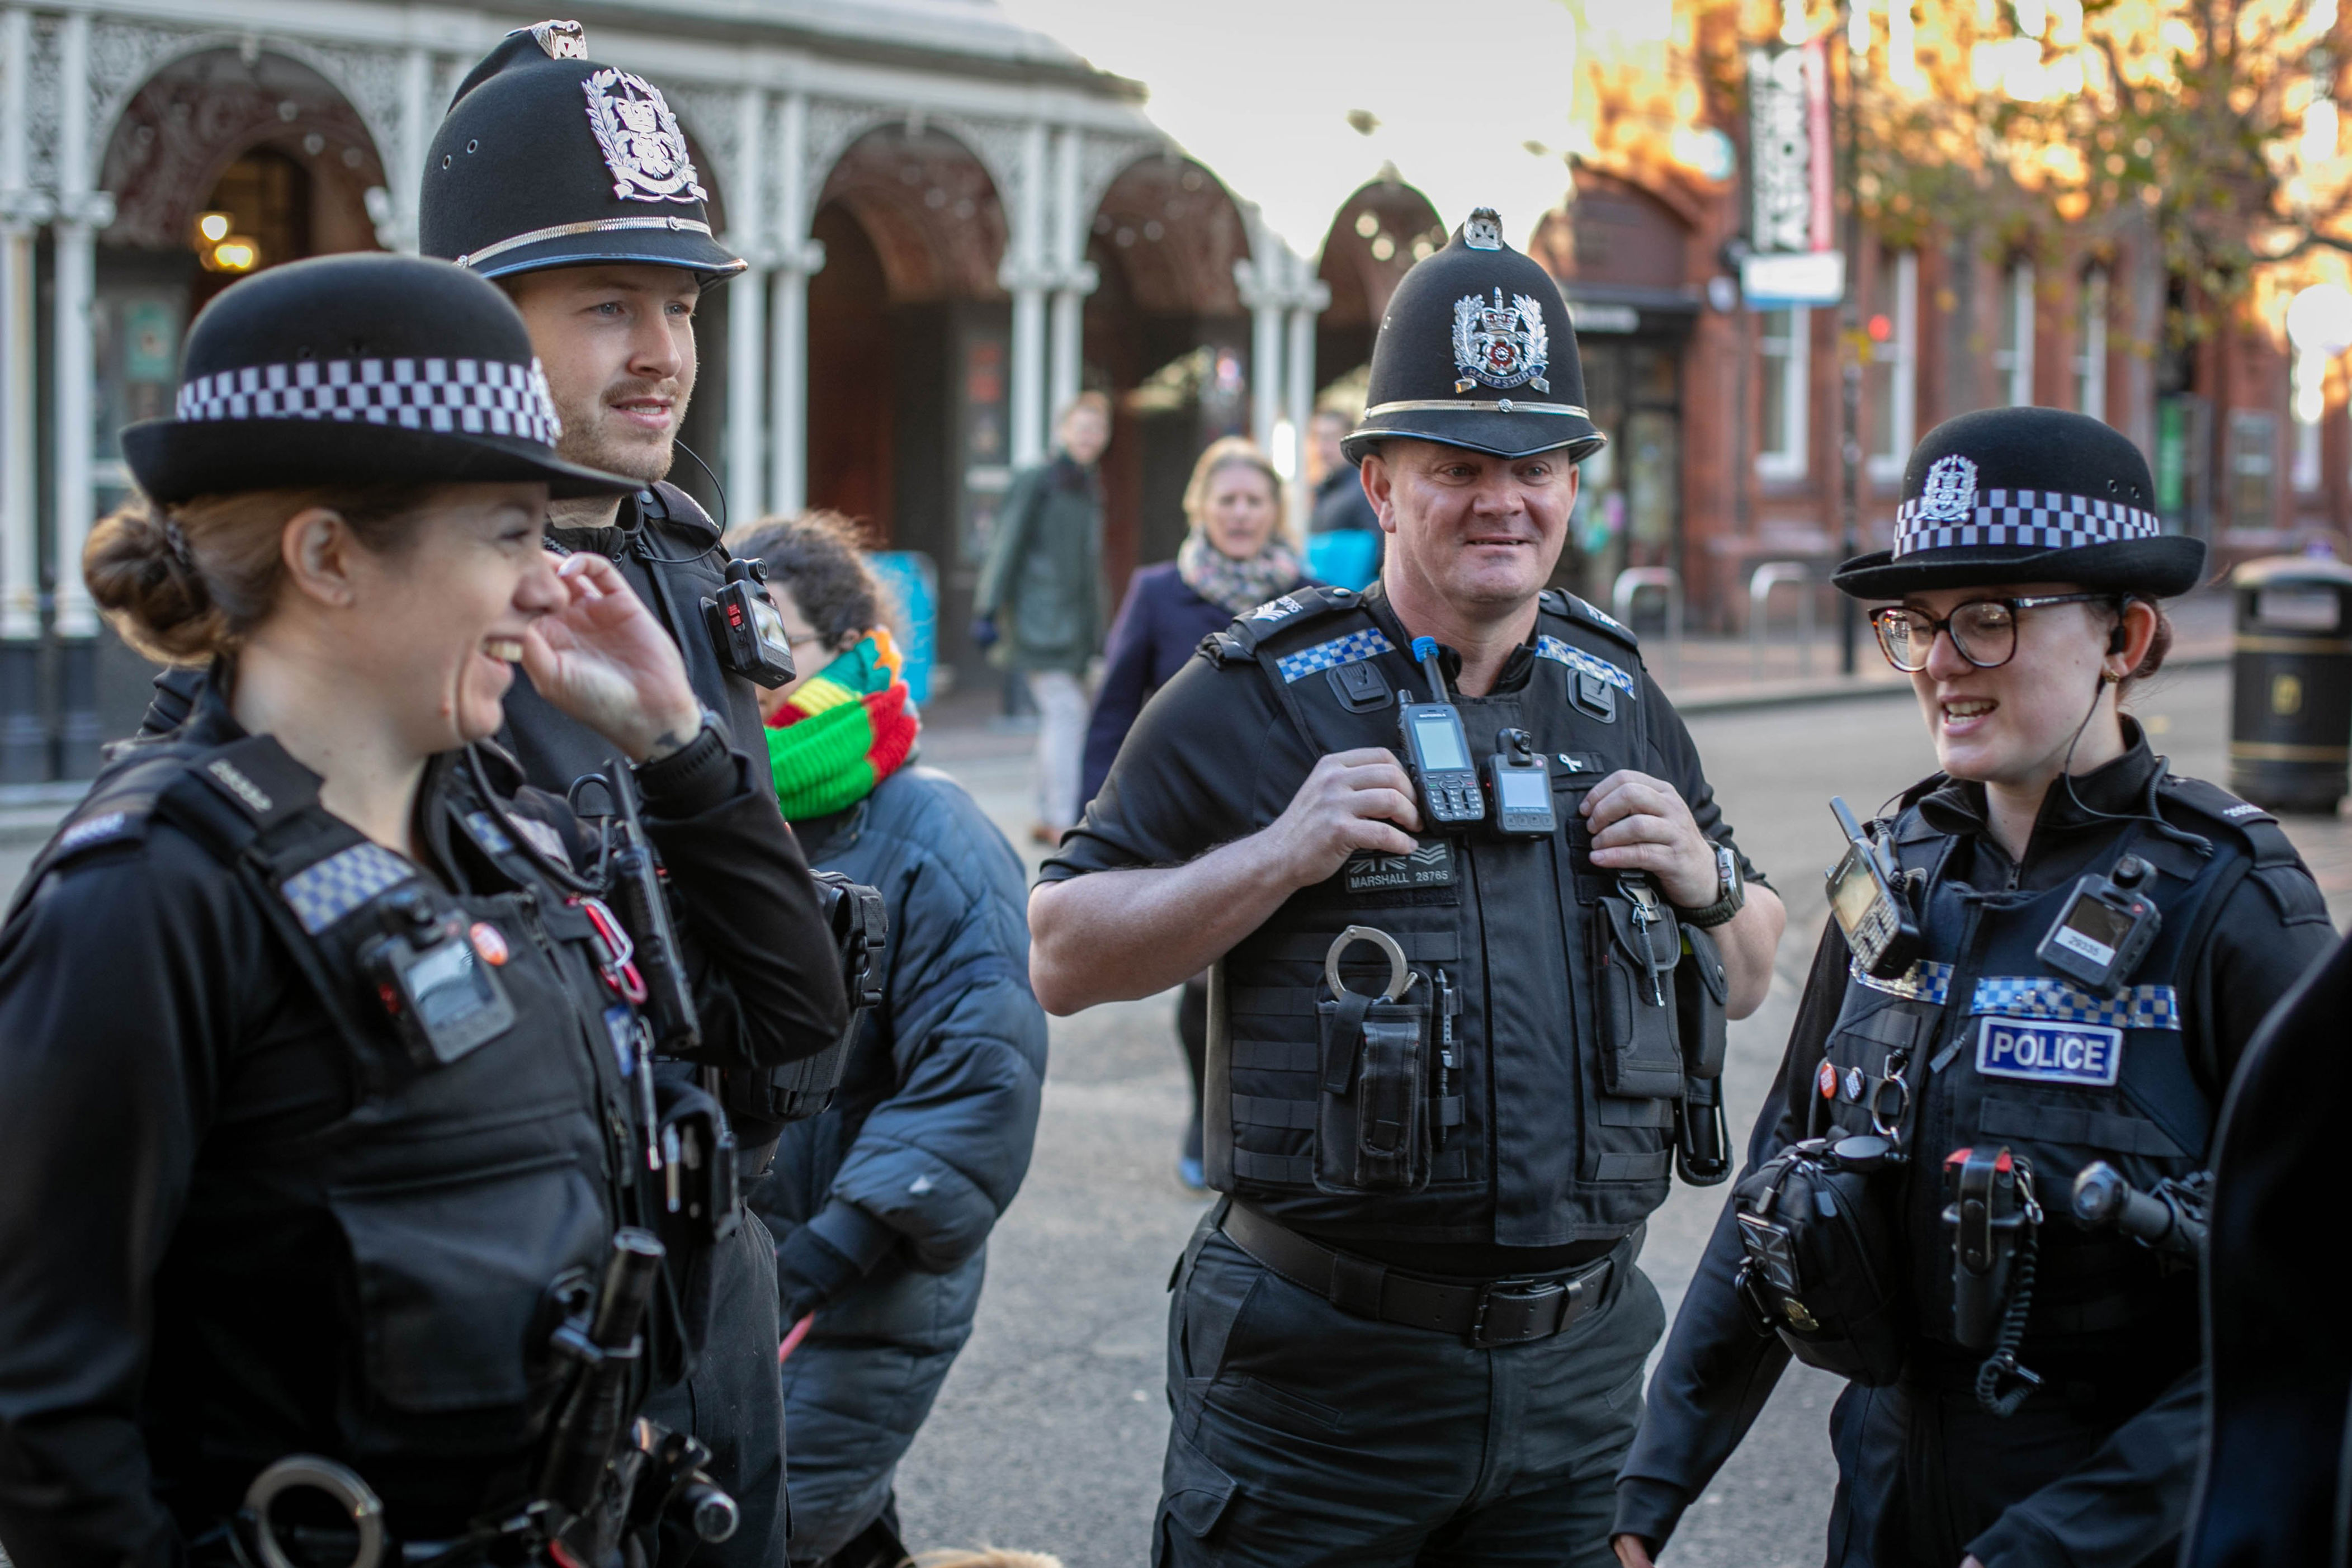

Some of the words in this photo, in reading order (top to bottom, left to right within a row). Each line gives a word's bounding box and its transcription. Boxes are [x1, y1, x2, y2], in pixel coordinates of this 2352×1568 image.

[1468, 367, 1538, 387] HAMPSHIRE
[1350, 873, 1410, 889] MARSHALL
[1415, 871, 1448, 882] 28765
[1991, 1031, 2106, 1071] POLICE
